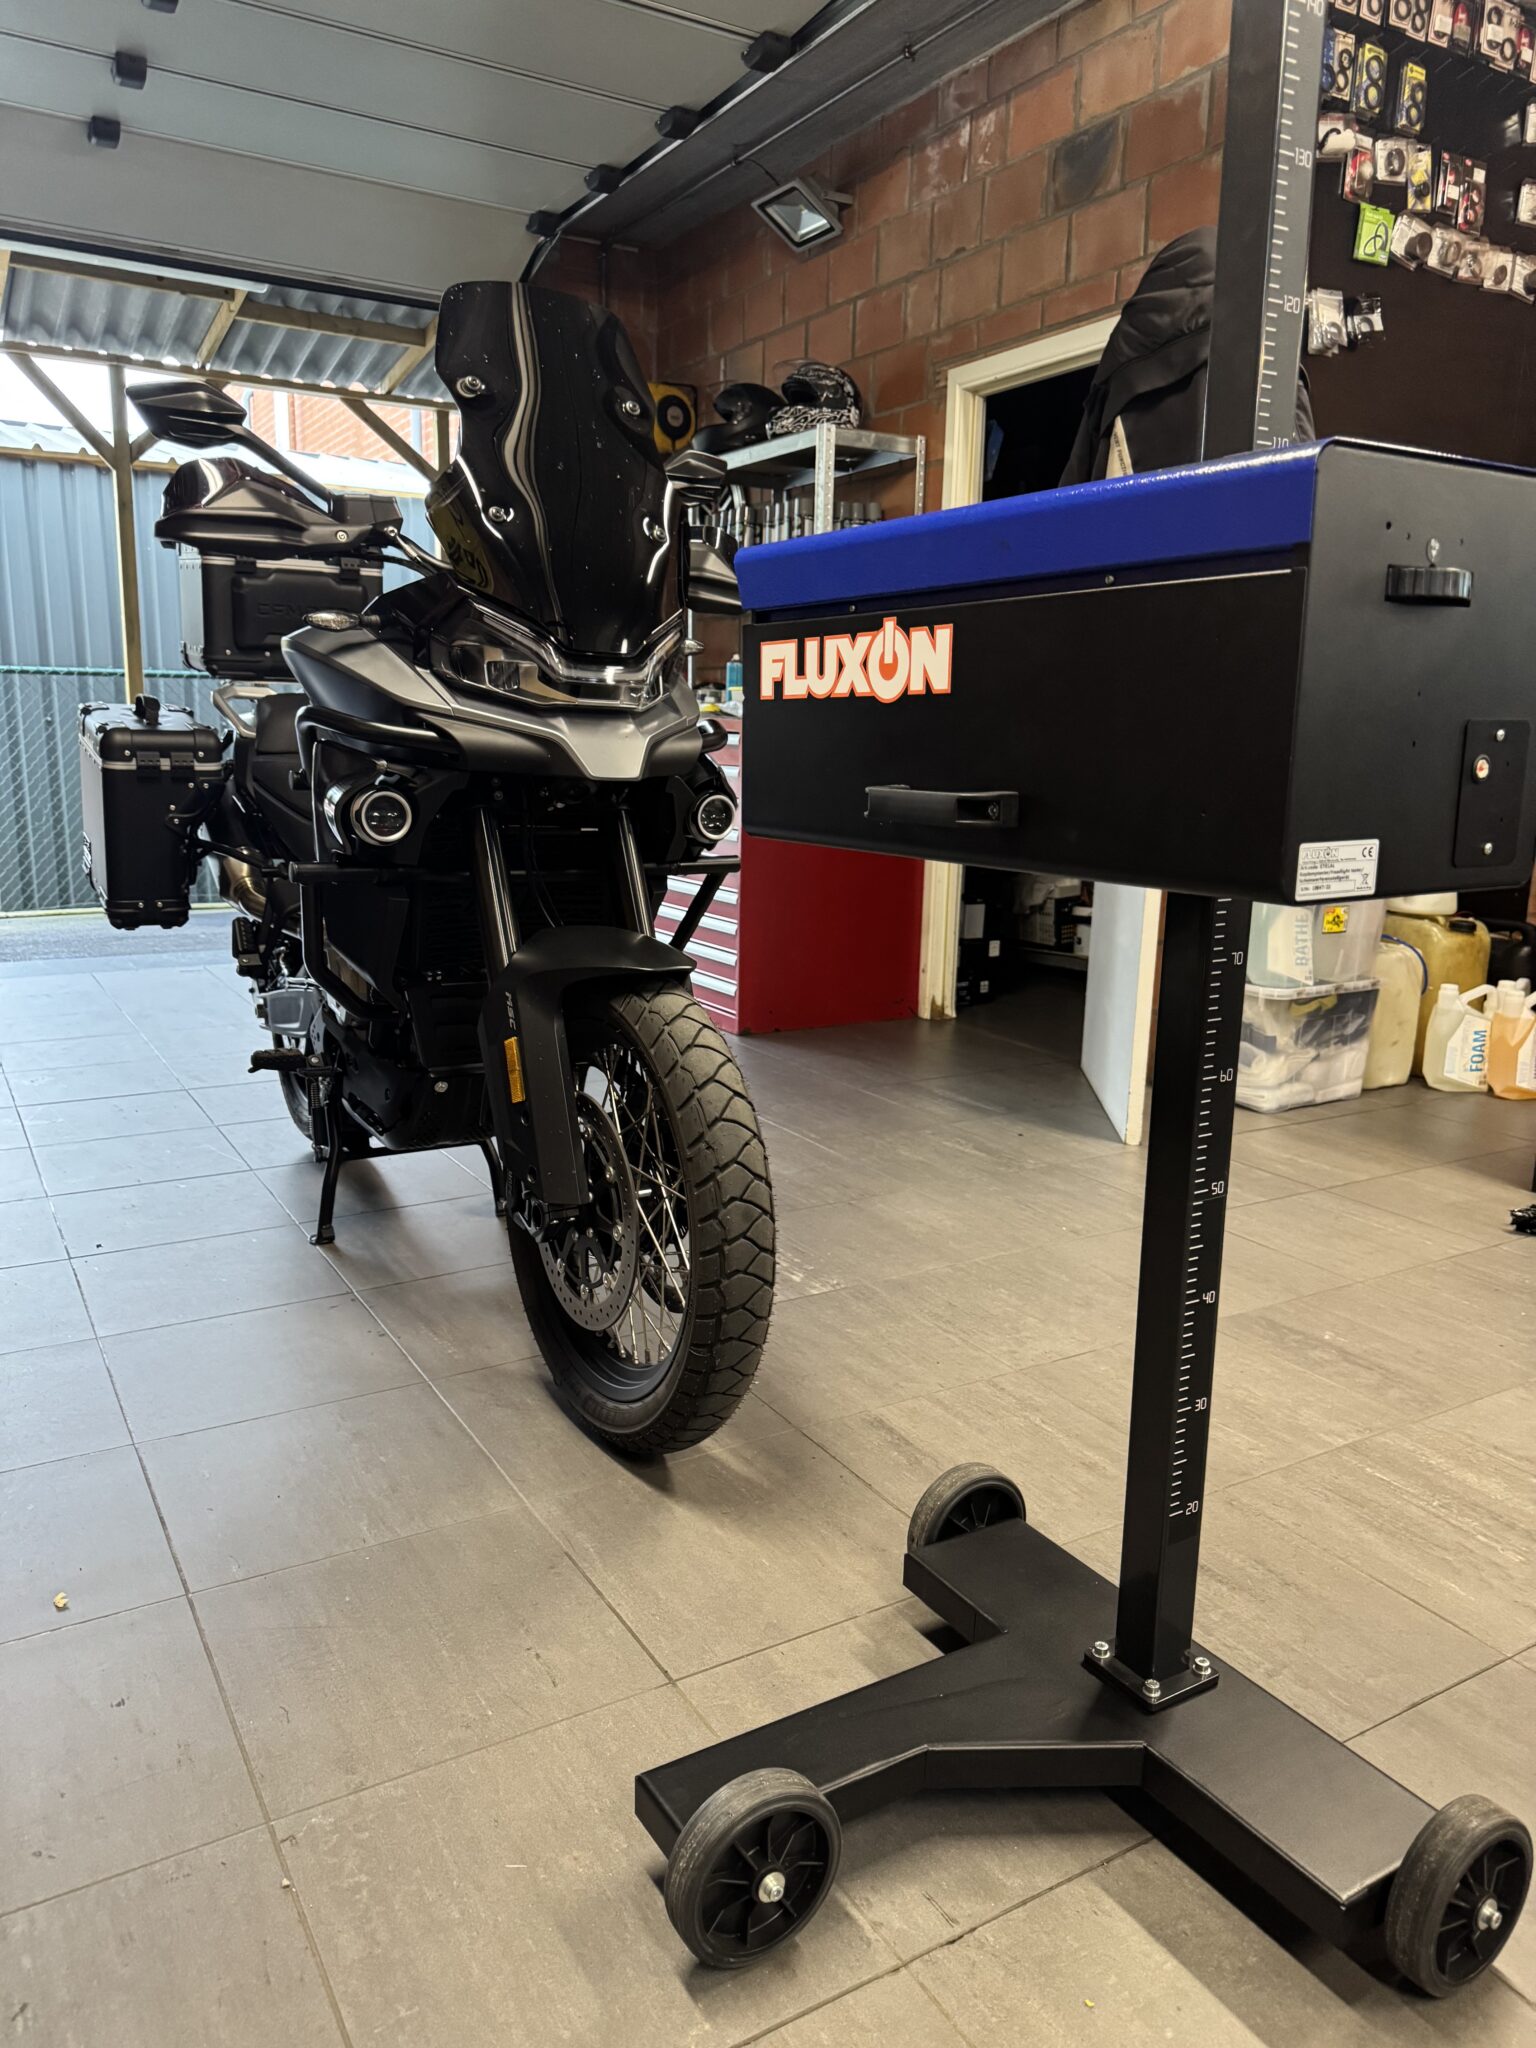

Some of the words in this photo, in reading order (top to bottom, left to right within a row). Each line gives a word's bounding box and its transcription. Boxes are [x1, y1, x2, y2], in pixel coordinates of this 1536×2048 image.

[1295, 146, 1312, 168] 130
[1284, 294, 1300, 314] 120
[760, 616, 953, 704] FLUXON
[1231, 951, 1244, 965] 70
[1469, 1029, 1488, 1073] FOAM
[1220, 1068, 1233, 1082] 60
[1211, 1180, 1224, 1195] 50
[1202, 1290, 1216, 1304] 40
[1194, 1397, 1207, 1412] 30
[1185, 1500, 1199, 1515] 20
